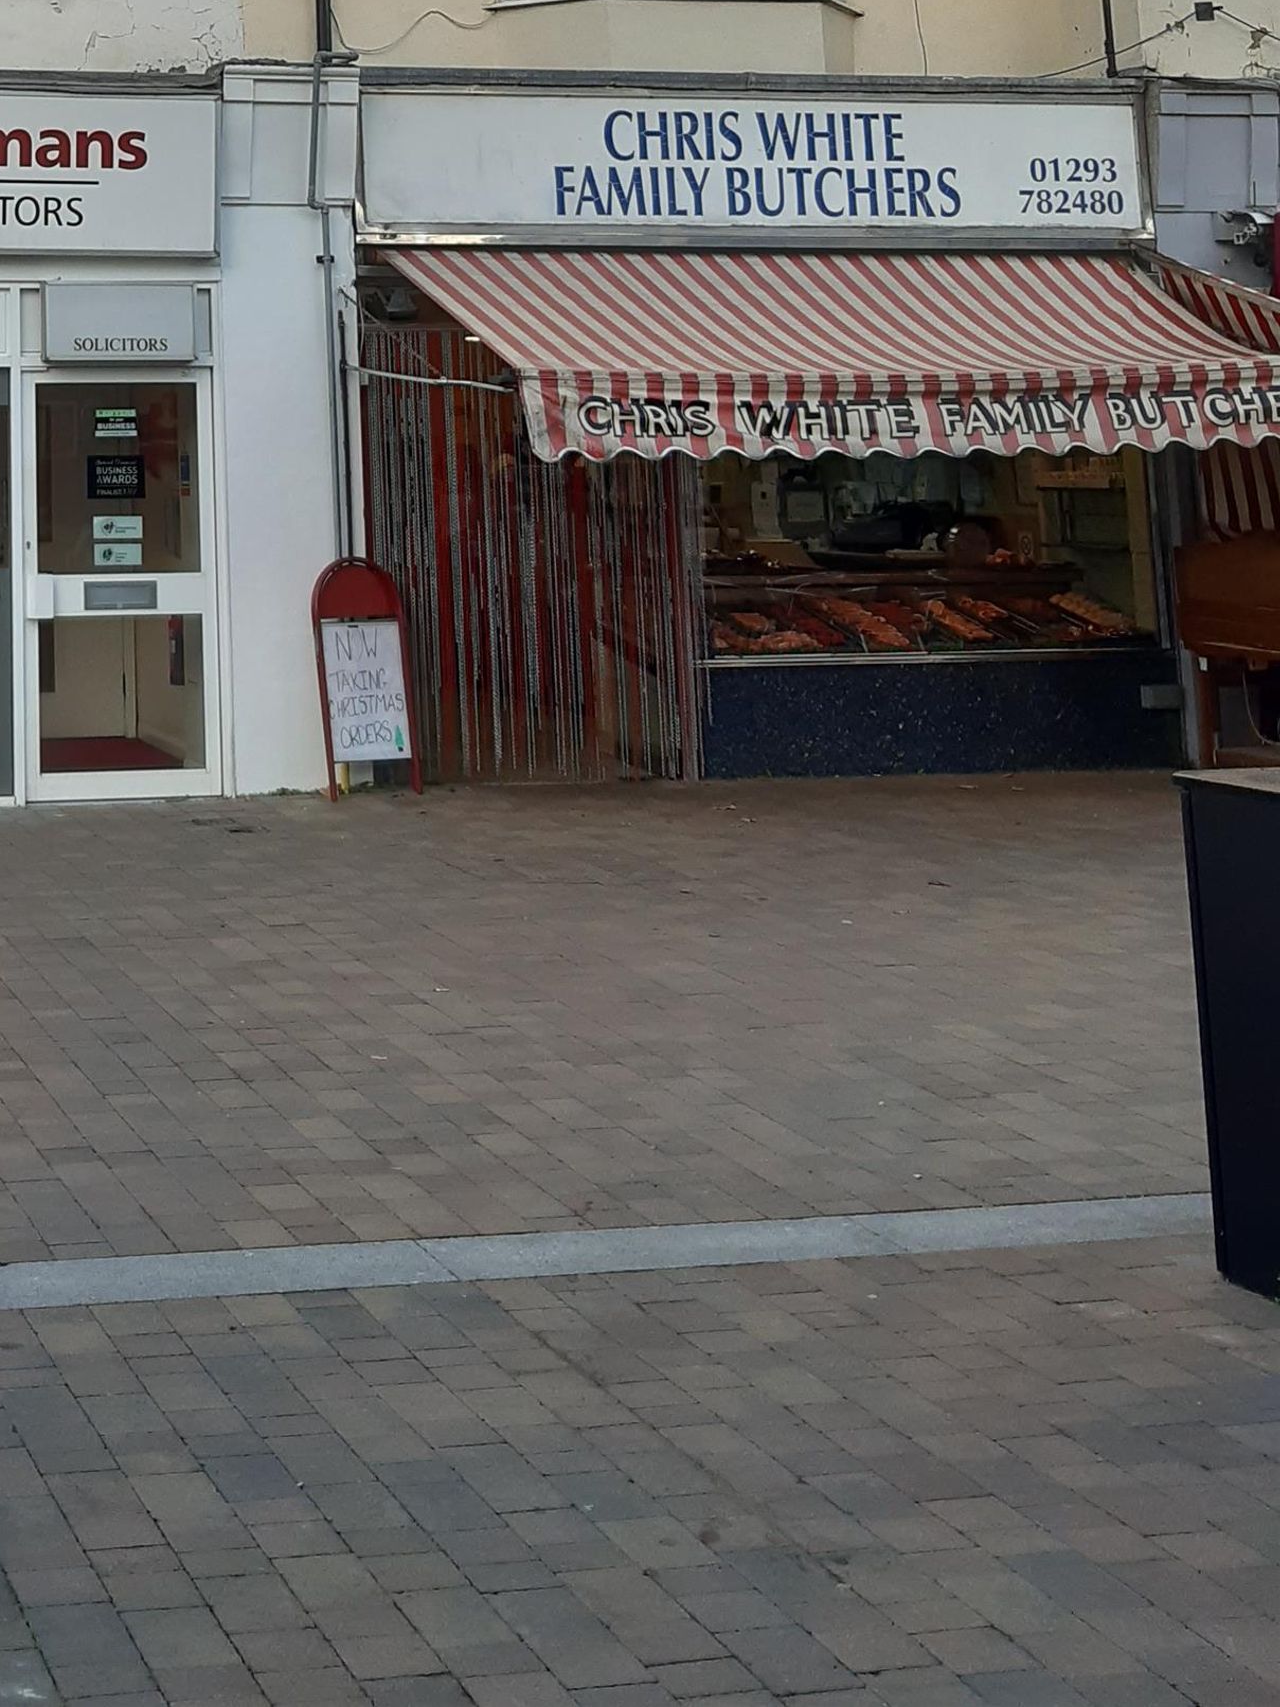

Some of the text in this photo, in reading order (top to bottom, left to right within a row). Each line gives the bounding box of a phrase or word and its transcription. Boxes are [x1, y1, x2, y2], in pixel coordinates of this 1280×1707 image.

[604, 110, 905, 162] CHRIS WHITE
[1029, 158, 1117, 184] 01293
[554, 165, 961, 218] FAMILY BUTCHERS
[1018, 189, 1124, 216] 782480
[73, 337, 168, 353] SOLICITORS
[577, 397, 718, 438] CHRIS
[735, 398, 921, 440] WHITE
[936, 394, 1094, 436] FAMILY
[96, 466, 138, 475] BUSINESS
[96, 474, 138, 484] AWARDS
[328, 668, 389, 692] TAKING
[329, 693, 405, 720] CHRISTMAS
[340, 720, 393, 749] ORDERS
